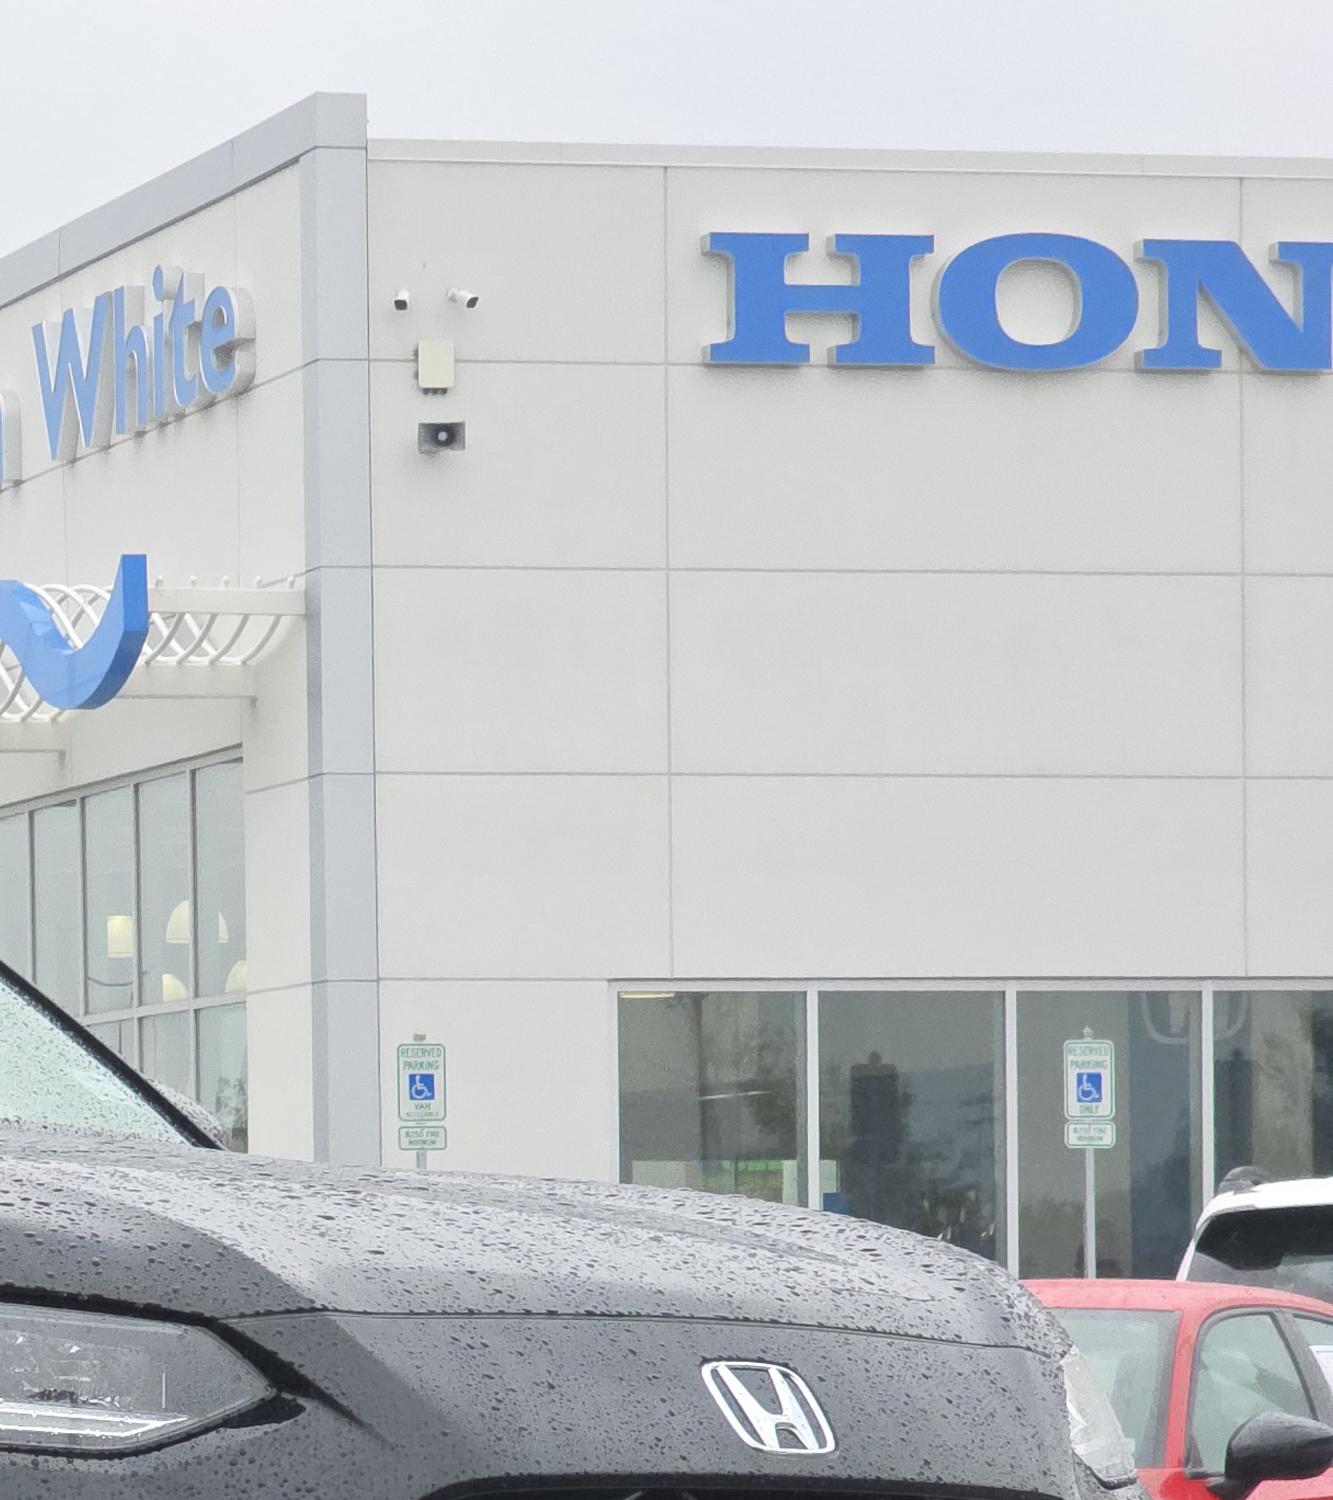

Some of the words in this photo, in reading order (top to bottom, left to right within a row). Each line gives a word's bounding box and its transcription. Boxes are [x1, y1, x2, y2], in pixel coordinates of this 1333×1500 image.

[700, 232, 1333, 372] HON
[30, 264, 256, 462] White
[400, 1047, 442, 1058] RESERVED
[403, 1060, 440, 1071] PARKING
[414, 1102, 431, 1110] VAN
